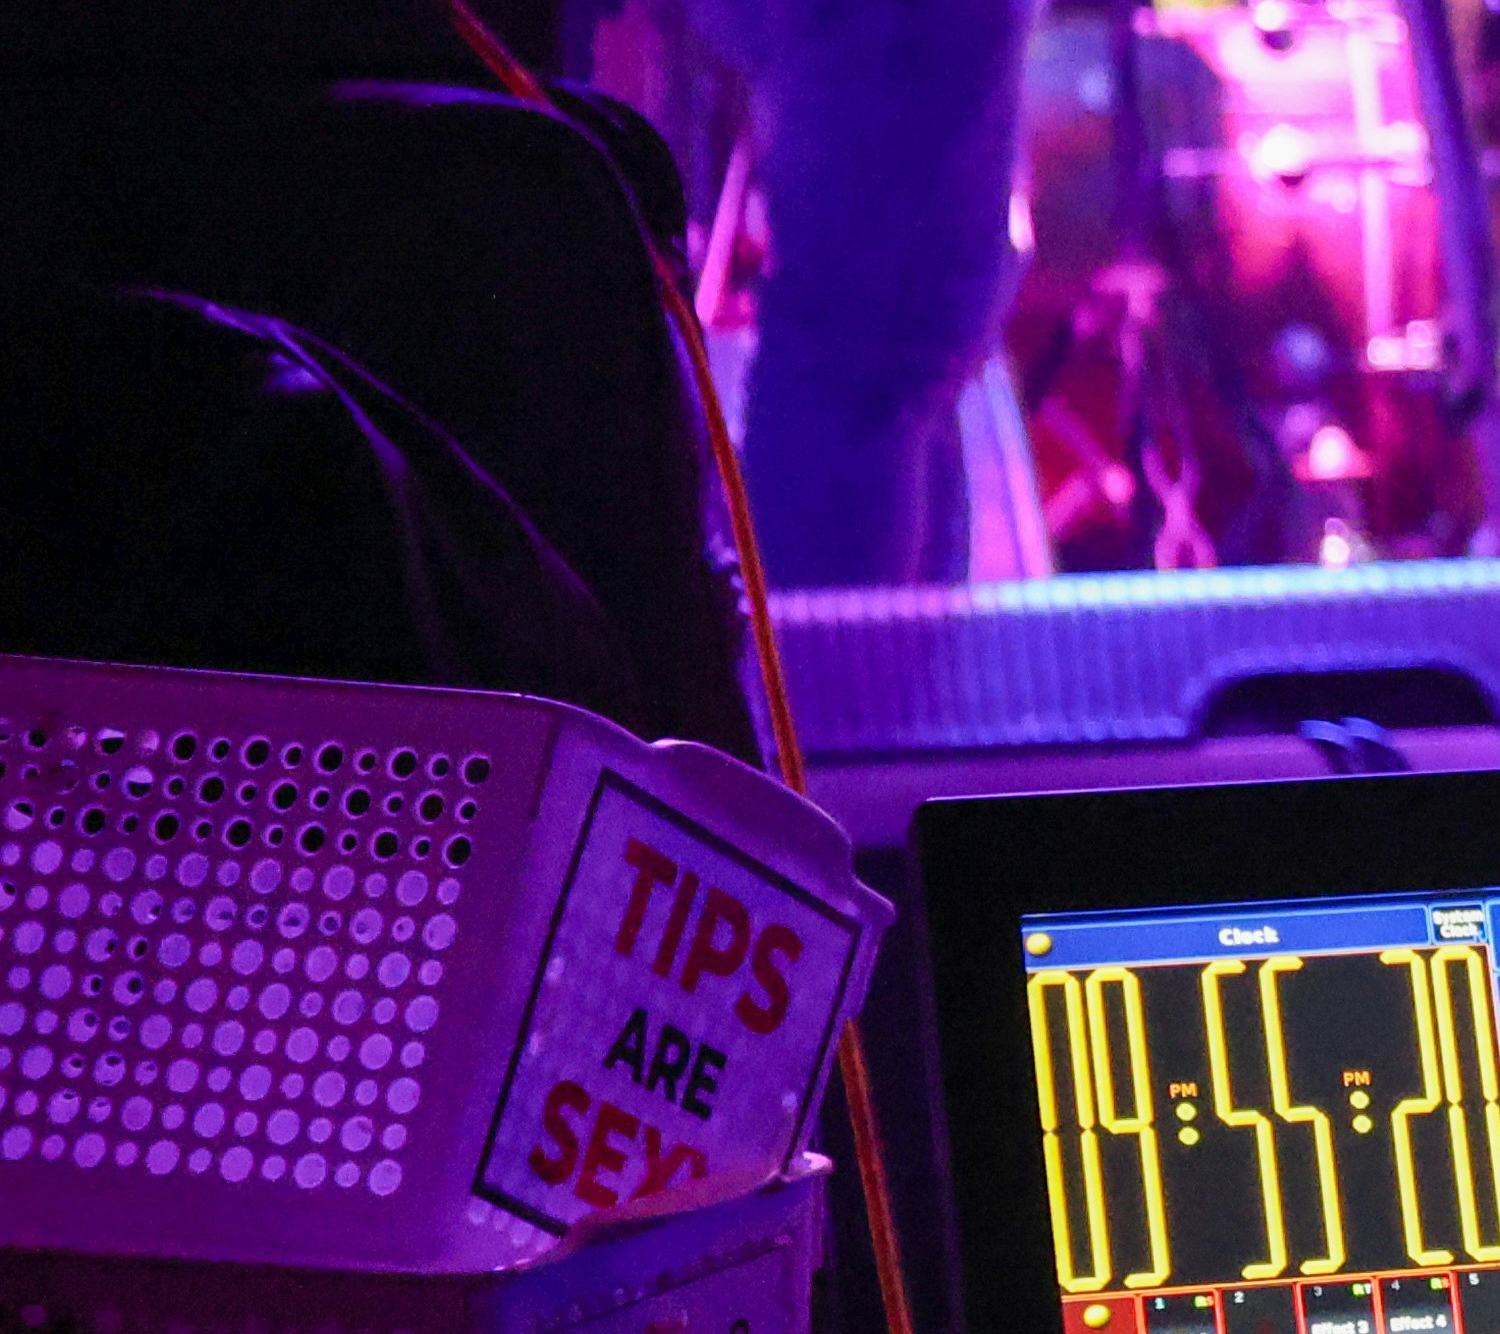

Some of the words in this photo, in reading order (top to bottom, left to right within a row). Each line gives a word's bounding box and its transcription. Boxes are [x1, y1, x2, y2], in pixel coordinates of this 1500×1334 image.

[1432, 908, 1483, 927] System
[613, 836, 805, 1035] TIPS
[1218, 926, 1280, 947] Clock
[1439, 924, 1479, 940] Clock
[603, 1008, 728, 1122] ARE
[1342, 1070, 1370, 1087] PM
[1168, 1081, 1198, 1099] PM
[1357, 1320, 1369, 1334] 3
[1390, 1317, 1431, 1333] Effect
[1434, 1315, 1447, 1328] 4
